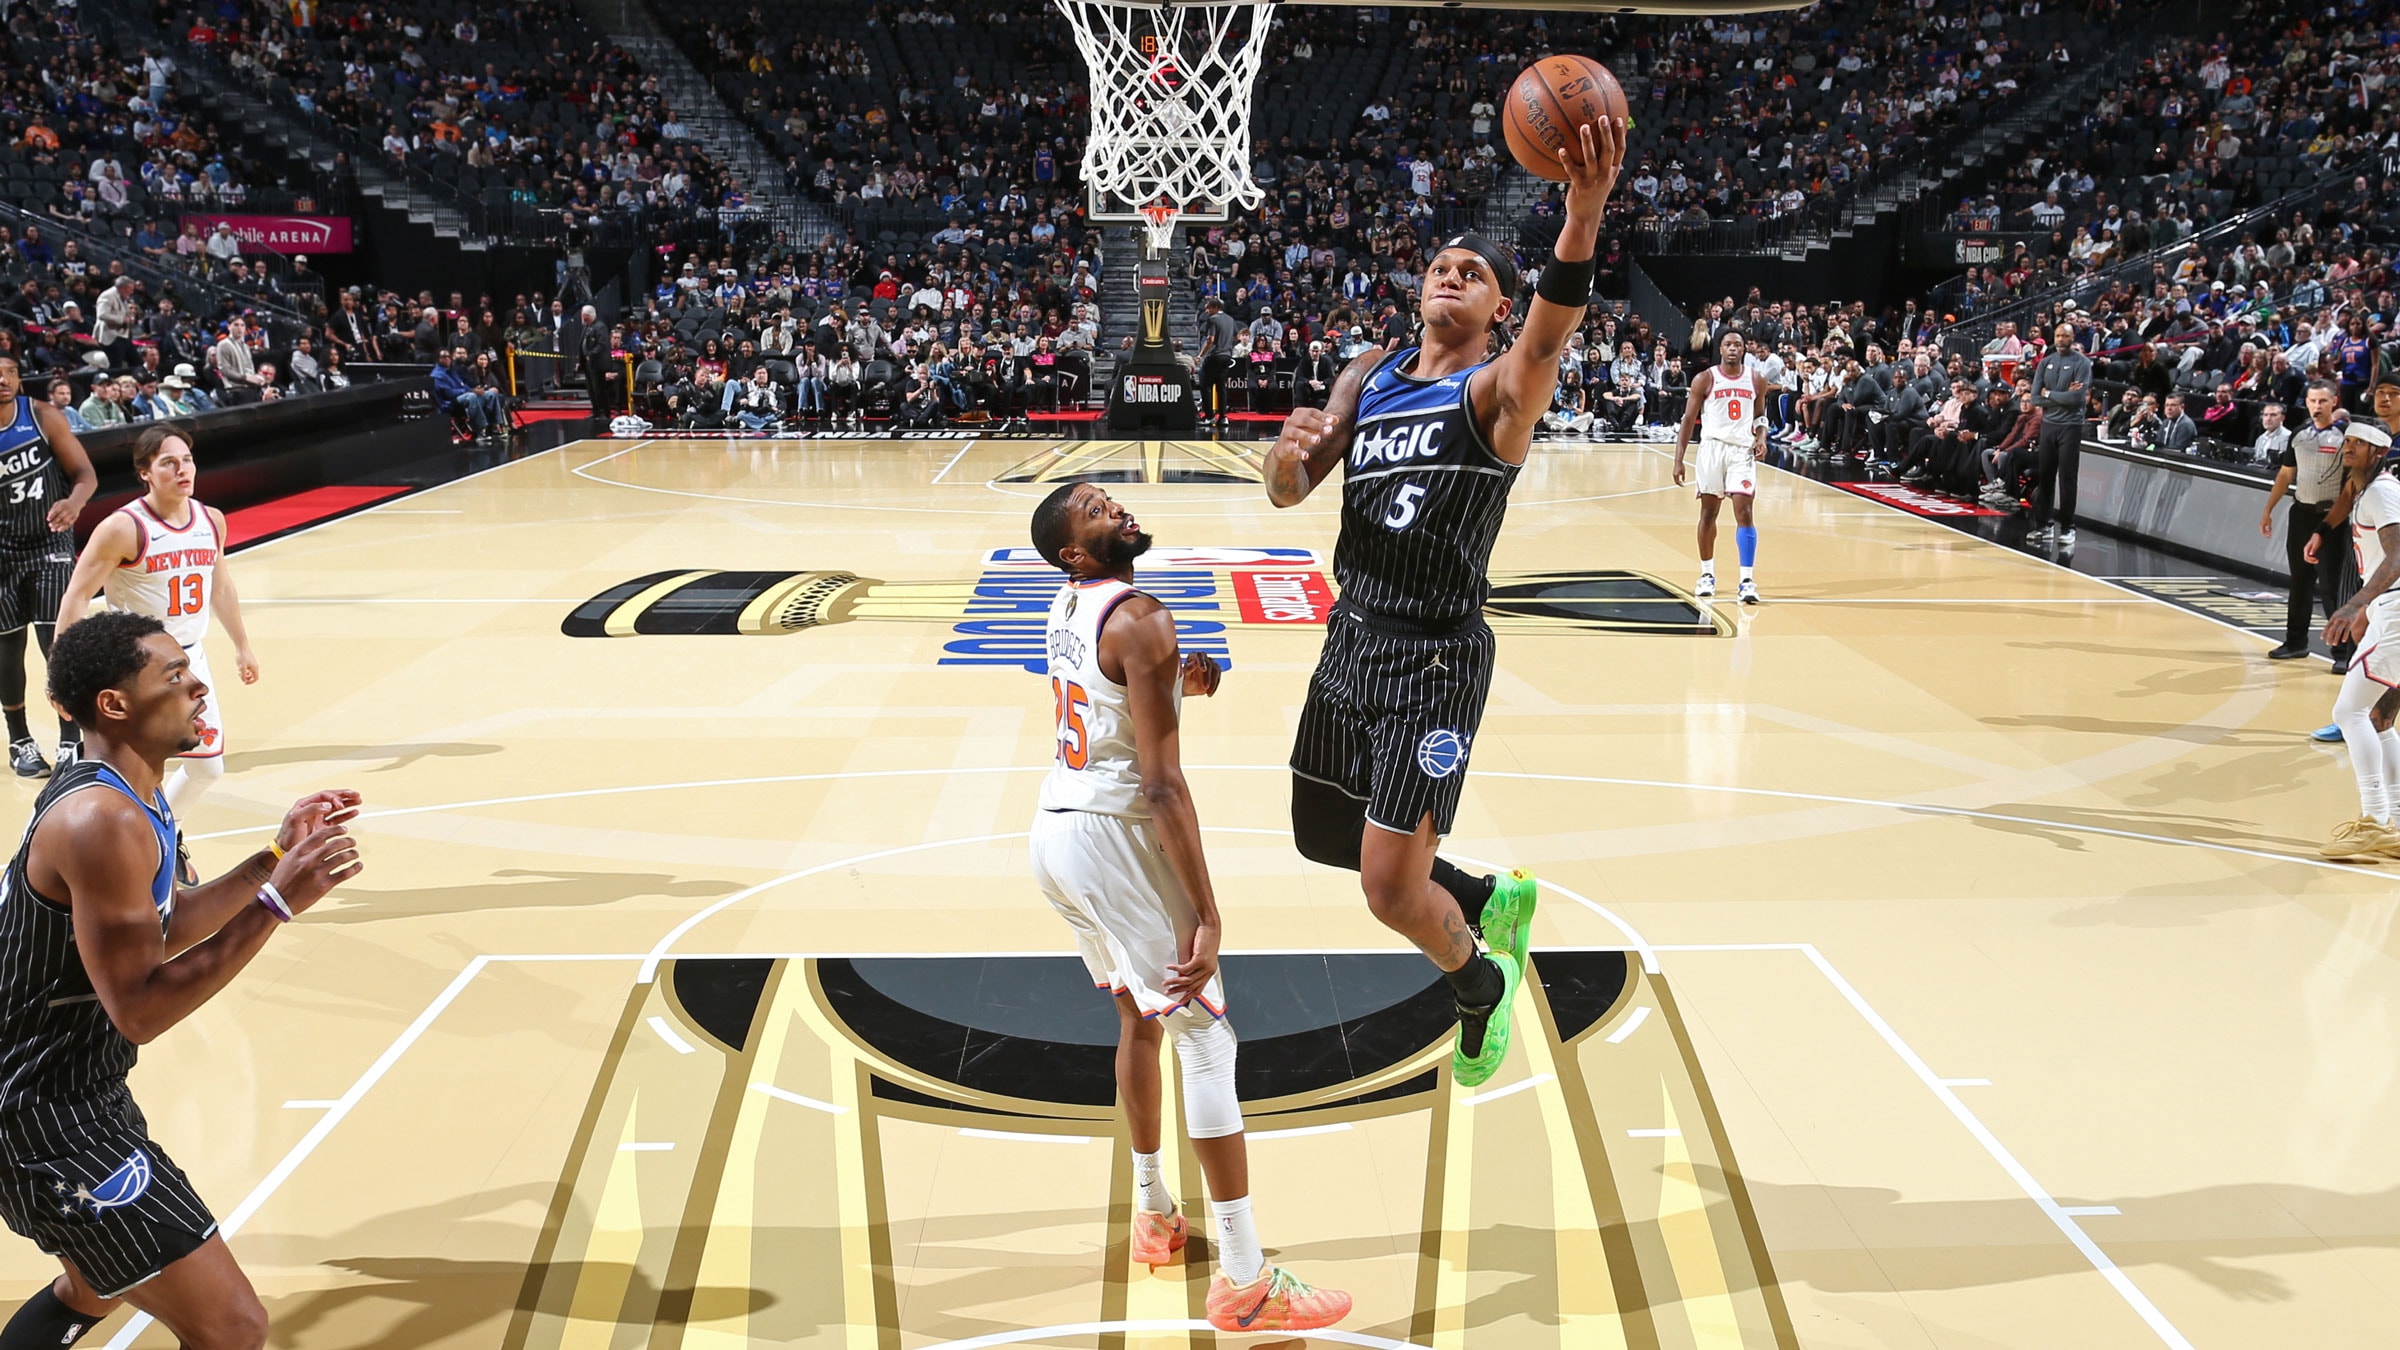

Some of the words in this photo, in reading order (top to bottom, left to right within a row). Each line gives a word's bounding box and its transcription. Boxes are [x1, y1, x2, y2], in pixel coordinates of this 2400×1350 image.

[1974, 220, 1988, 231] EXIT
[269, 231, 321, 243] ARENA
[1966, 247, 1982, 263] NBA
[1983, 247, 1999, 263] CUP
[1138, 384, 1159, 402] NBA
[1160, 384, 1182, 402] CUP
[1714, 389, 1732, 400] NEW
[1734, 388, 1753, 400] YORK
[1728, 399, 1742, 421] 8
[812, 431, 892, 439] NBA
[901, 431, 981, 439] CUP
[9, 476, 44, 504] 34
[1384, 482, 1427, 531] 5
[145, 550, 182, 574] NEW
[183, 548, 217, 567] YORK
[167, 573, 203, 617] 13
[1252, 573, 1322, 620] Emirates
[1049, 628, 1086, 671] BRIDGES
